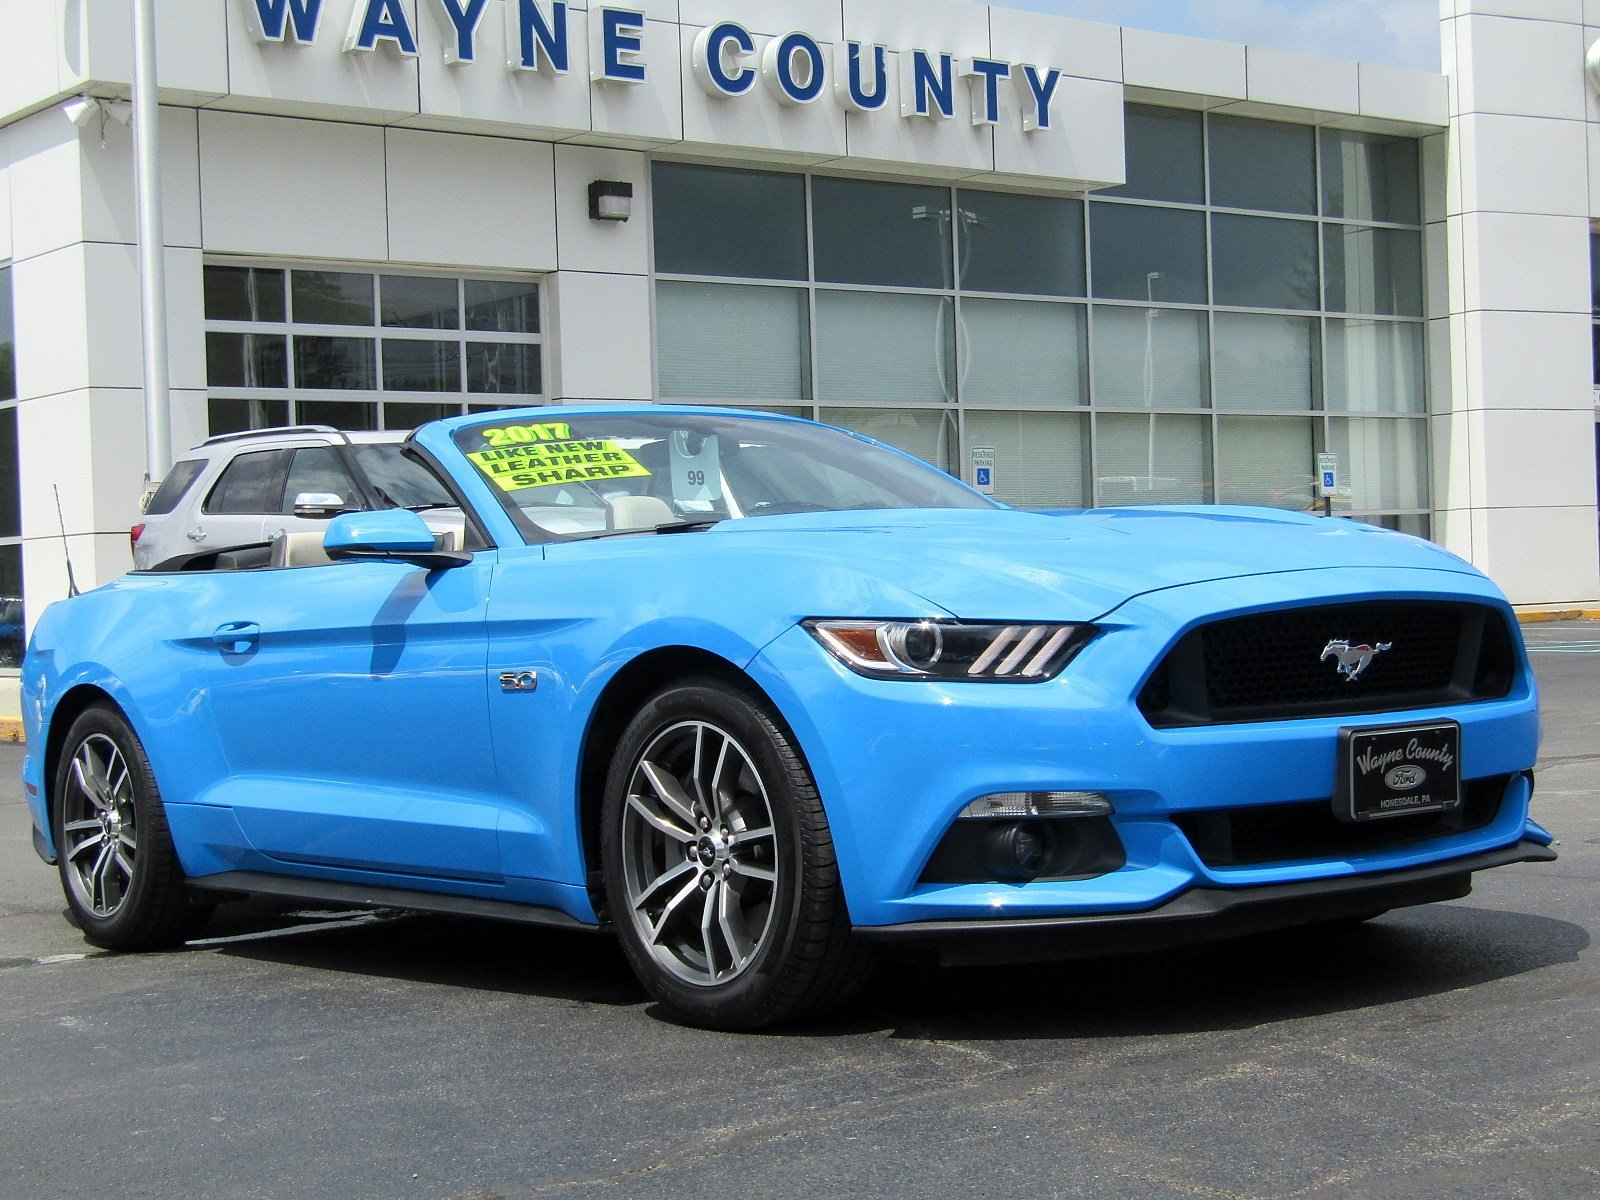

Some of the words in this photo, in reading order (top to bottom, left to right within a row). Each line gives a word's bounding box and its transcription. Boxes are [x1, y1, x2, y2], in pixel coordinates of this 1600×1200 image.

[254, 0, 646, 82] WAYNE
[703, 22, 1063, 132] COUNTY
[482, 422, 572, 448] 2017
[481, 446, 538, 462] LIKE
[544, 440, 604, 454] NEW
[491, 451, 623, 474] LEATHER
[512, 465, 630, 486] SHARP
[687, 470, 705, 486] 99
[1356, 745, 1404, 775] Wayne
[1405, 738, 1454, 772] County
[1392, 770, 1418, 786] Ford
[1421, 794, 1431, 803] PA
